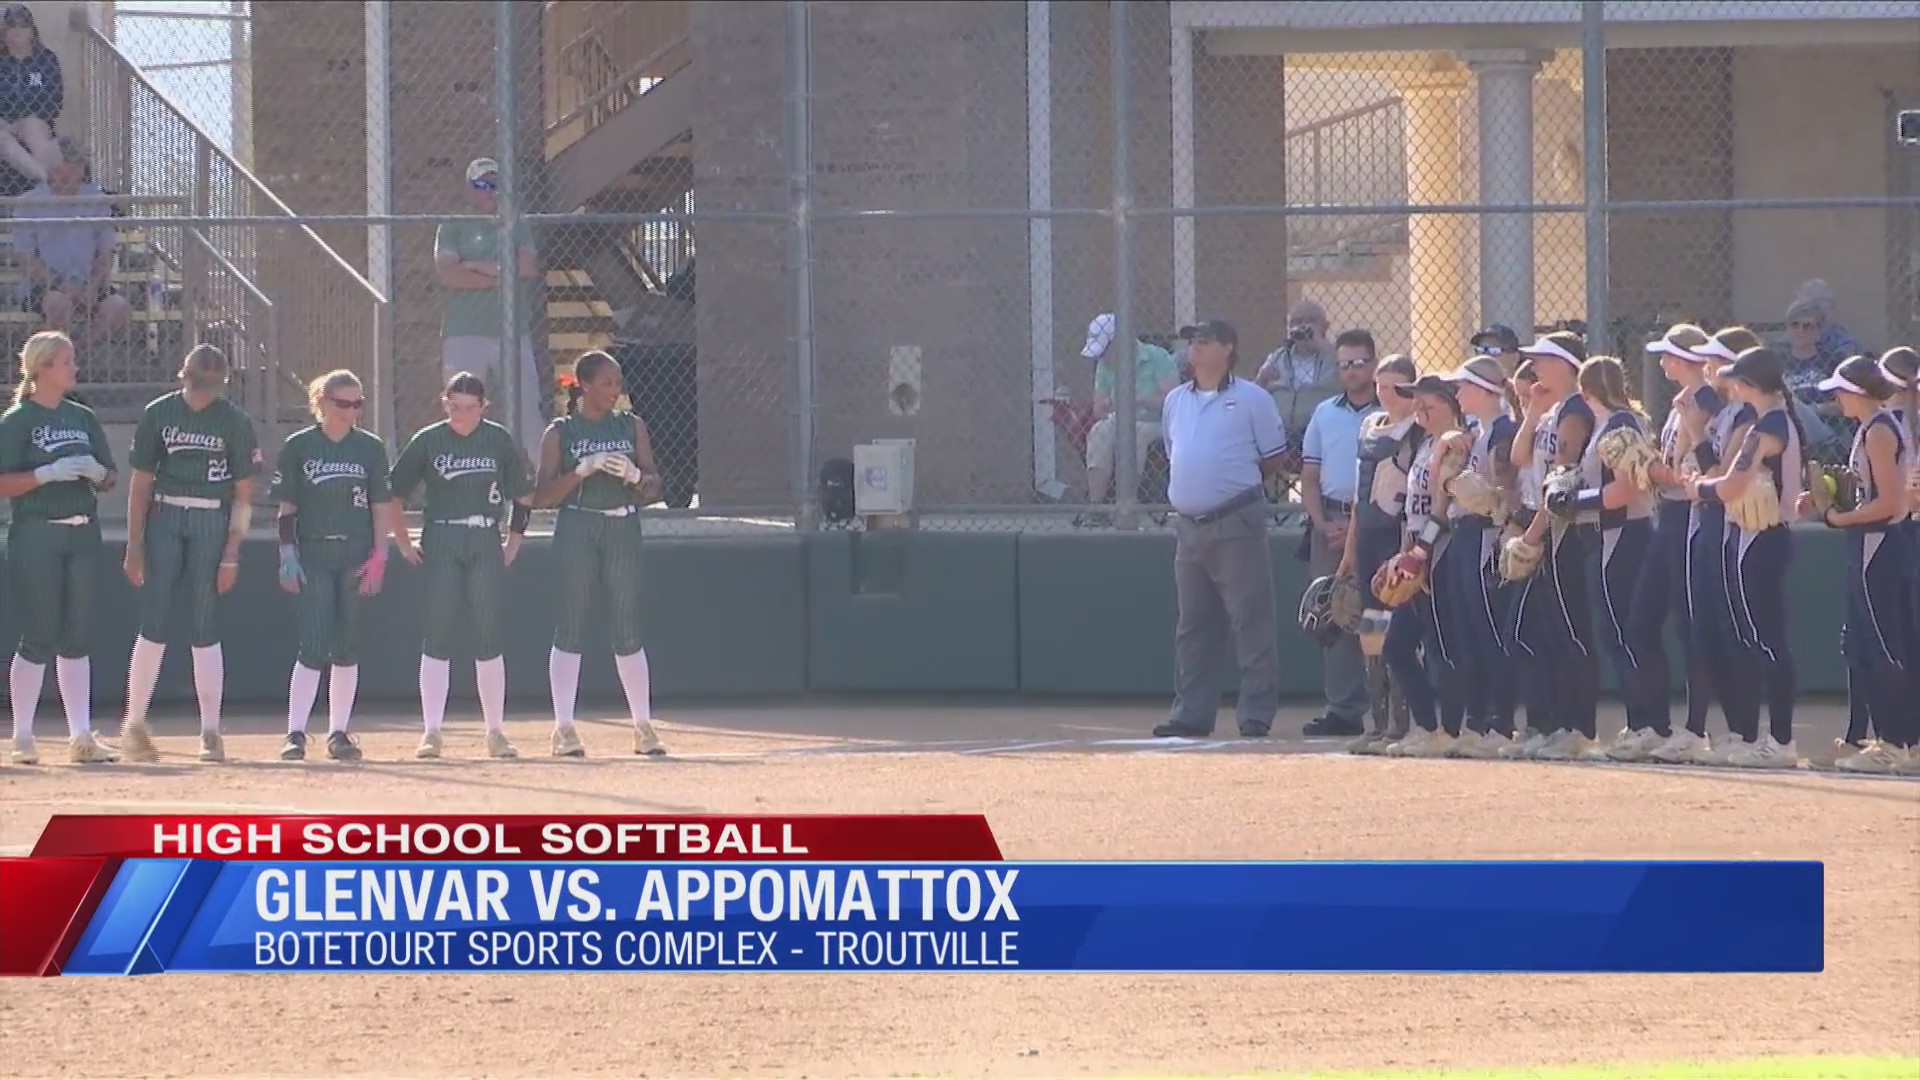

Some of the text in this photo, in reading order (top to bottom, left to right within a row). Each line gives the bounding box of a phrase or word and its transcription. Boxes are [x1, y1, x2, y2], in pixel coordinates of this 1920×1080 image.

[162, 425, 226, 447] Glenvar
[302, 457, 366, 480] Glenvar
[433, 453, 497, 477] Glenvar
[488, 481, 502, 504] 6
[1411, 493, 1432, 516] 22
